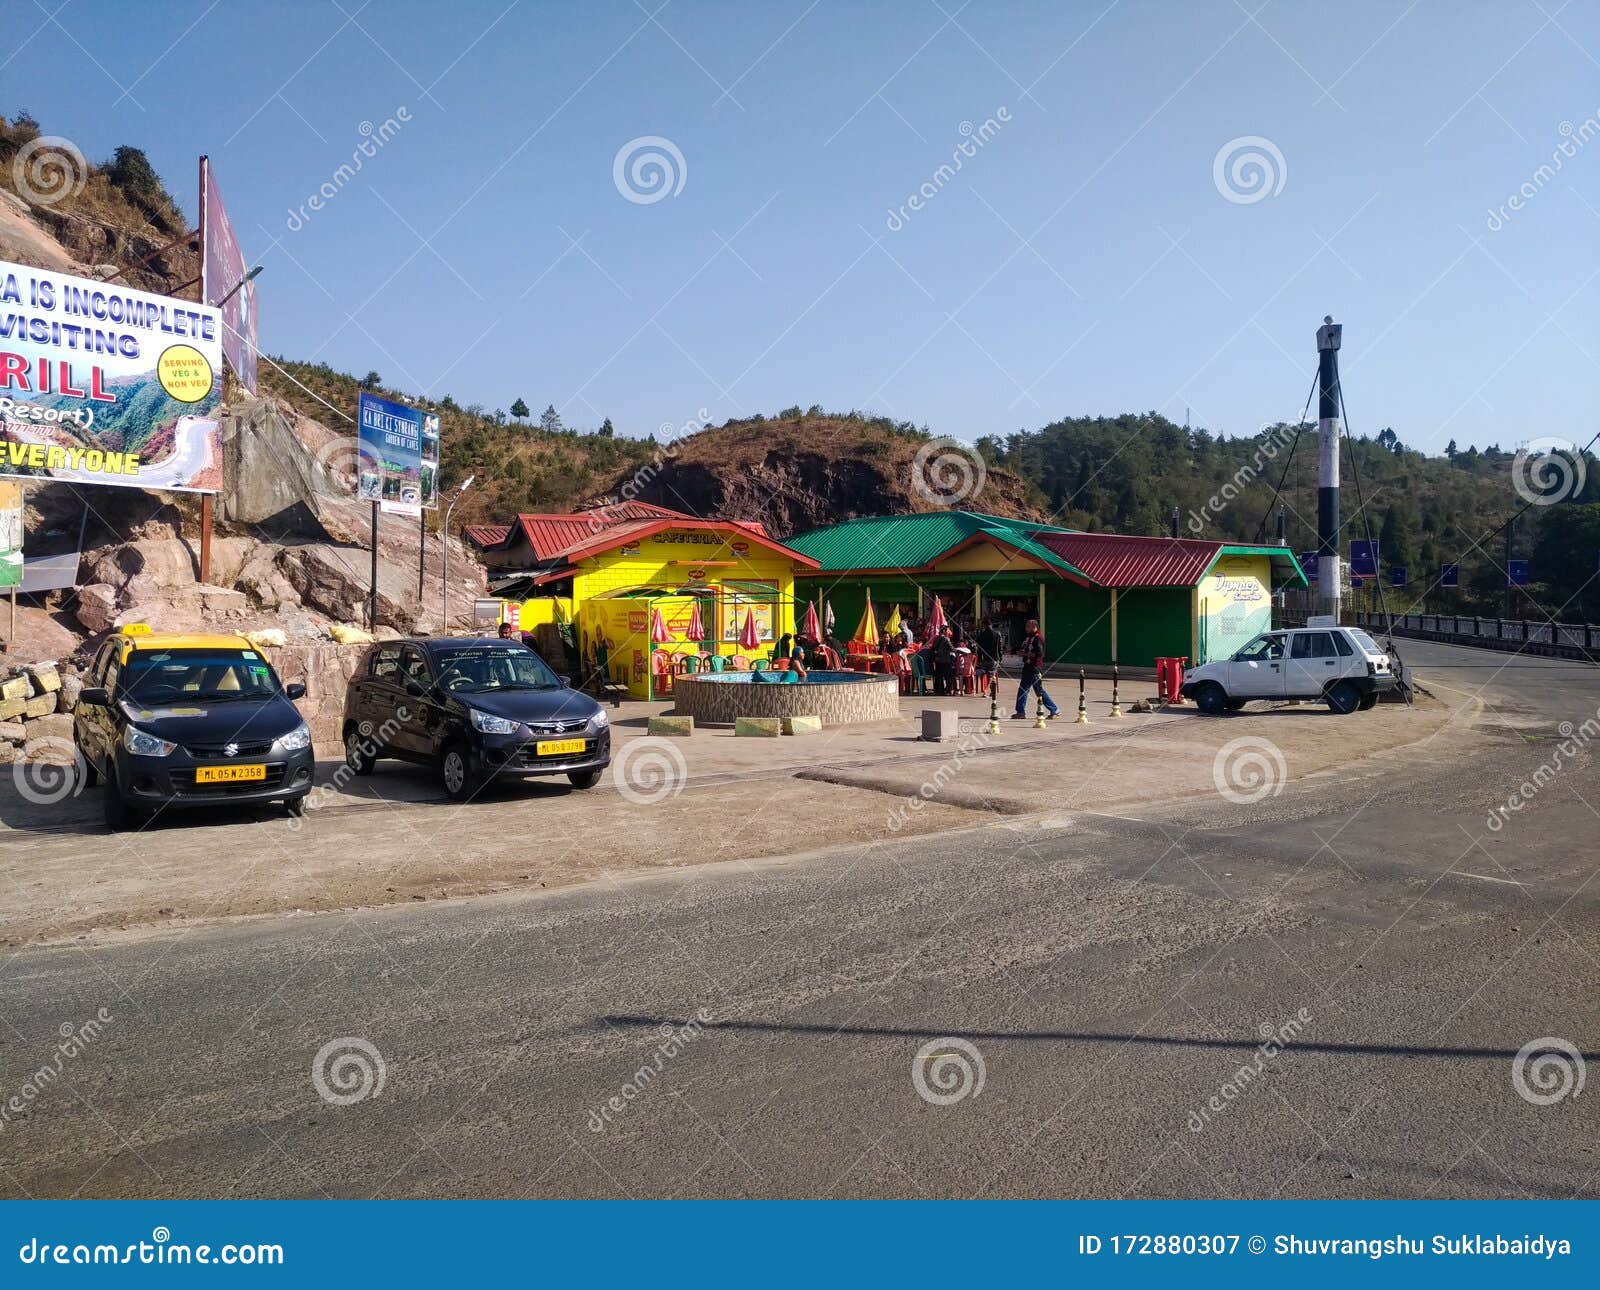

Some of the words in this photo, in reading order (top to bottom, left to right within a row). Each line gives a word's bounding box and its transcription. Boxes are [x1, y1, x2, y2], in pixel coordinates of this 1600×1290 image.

[0, 273, 22, 306] A
[31, 277, 56, 312] IS
[64, 285, 215, 342] INCOMPLETE
[164, 359, 204, 367] SERVING
